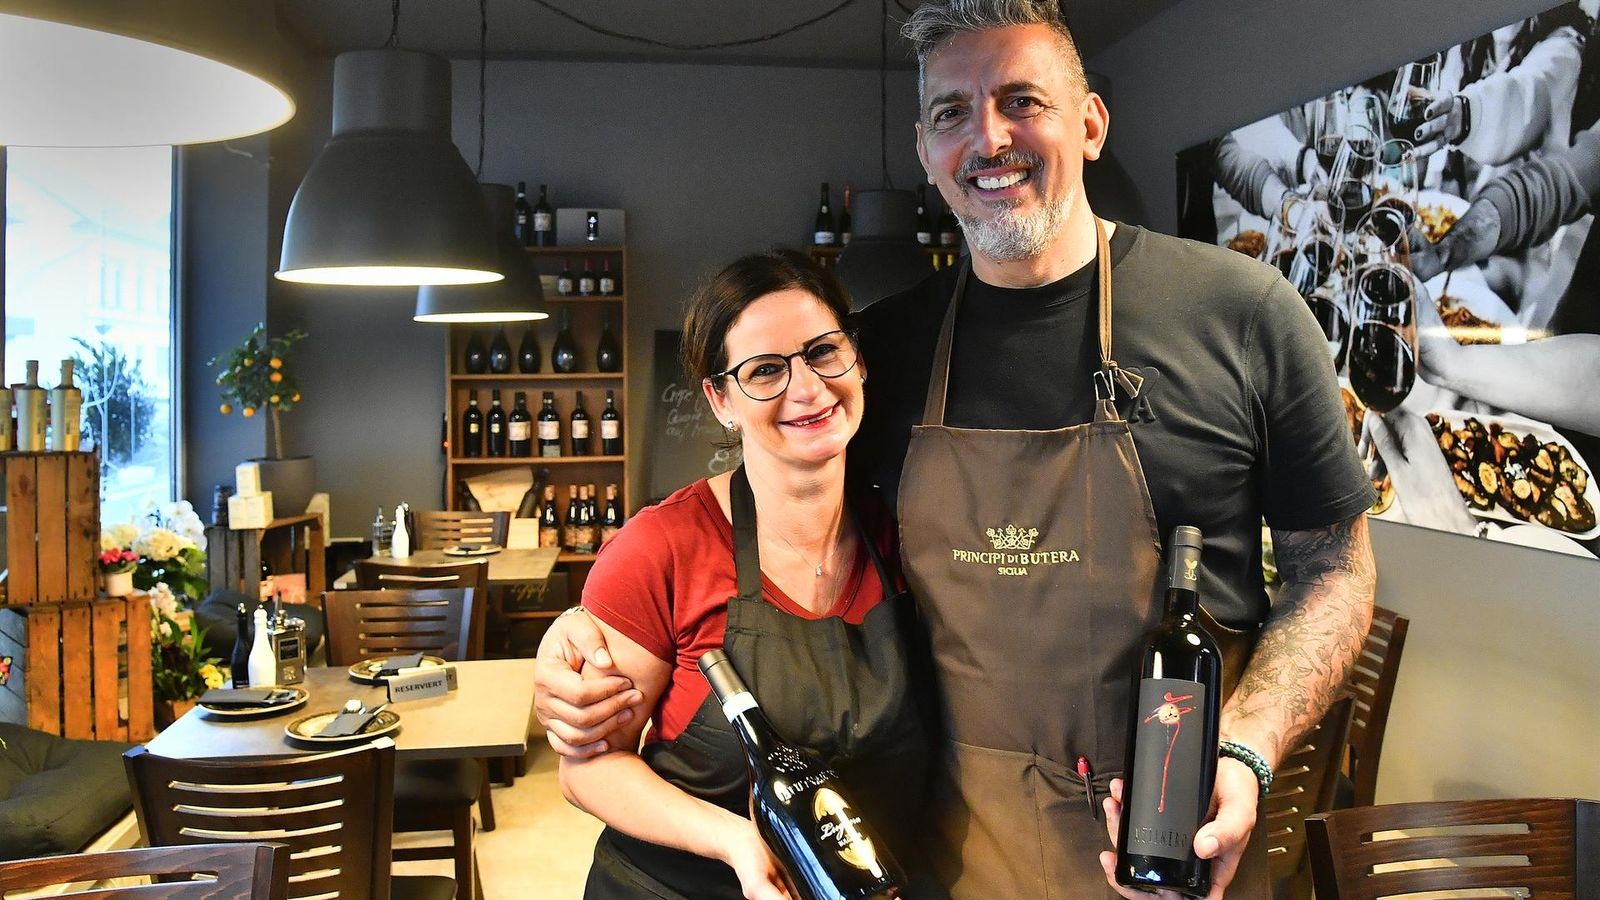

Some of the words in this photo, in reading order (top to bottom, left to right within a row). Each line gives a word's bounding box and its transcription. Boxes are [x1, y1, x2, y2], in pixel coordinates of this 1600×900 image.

[952, 549, 1005, 565] PRINCIPI
[1007, 554, 1019, 564] DI
[1020, 549, 1080, 565] BUTERA
[997, 567, 1028, 576] SICILIA
[394, 680, 443, 693] RESERVIERT
